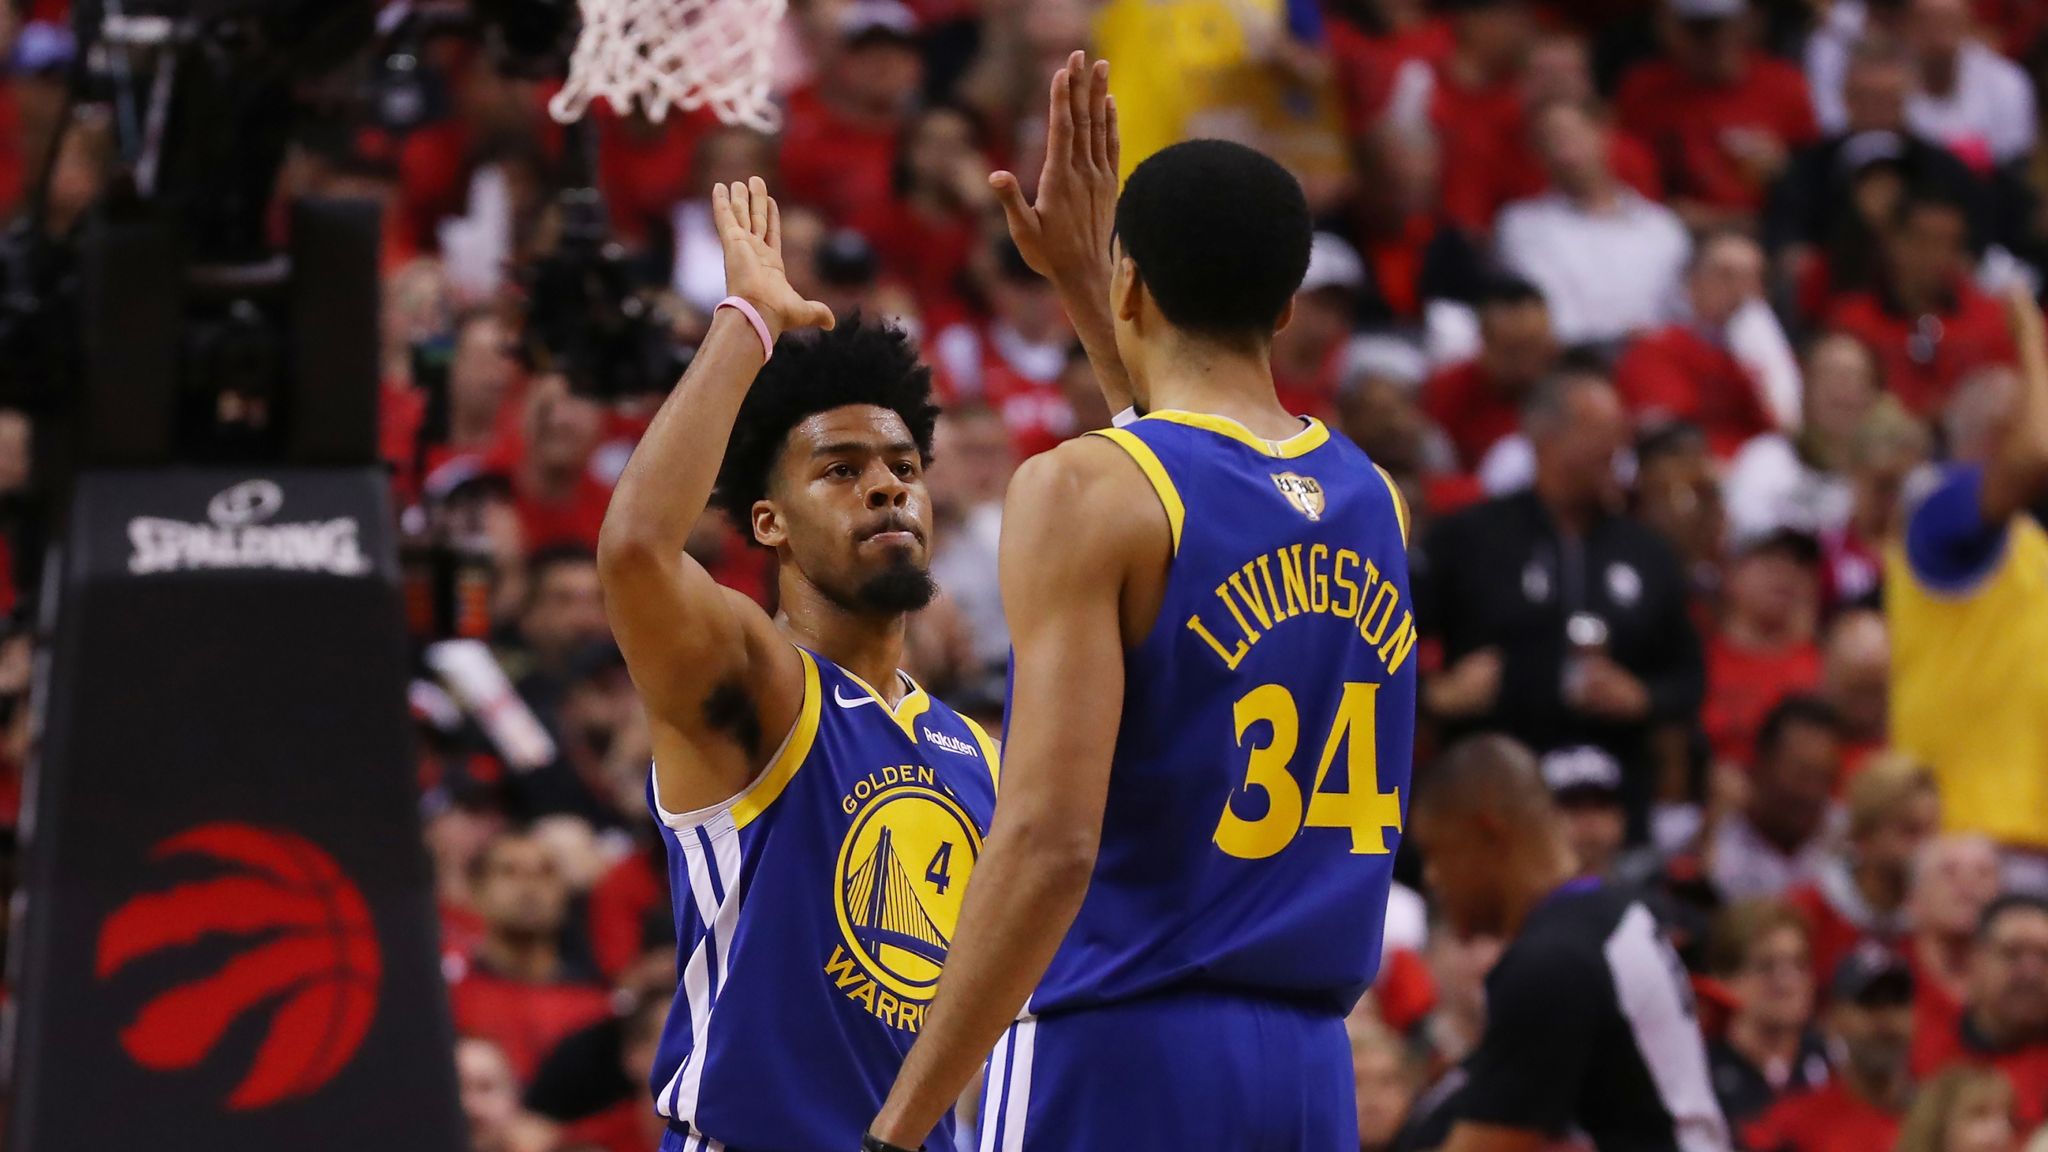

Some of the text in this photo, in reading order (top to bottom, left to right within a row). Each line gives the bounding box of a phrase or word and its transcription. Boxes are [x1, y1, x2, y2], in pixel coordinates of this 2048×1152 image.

[127, 516, 372, 575] SPALDING
[1186, 544, 1417, 676] LIVINGSTON
[923, 726, 978, 757] Rakuten
[1212, 682, 1402, 860] 34
[842, 765, 934, 815] GOLDEN
[925, 841, 953, 895] 4
[823, 944, 933, 1033] WARRI
